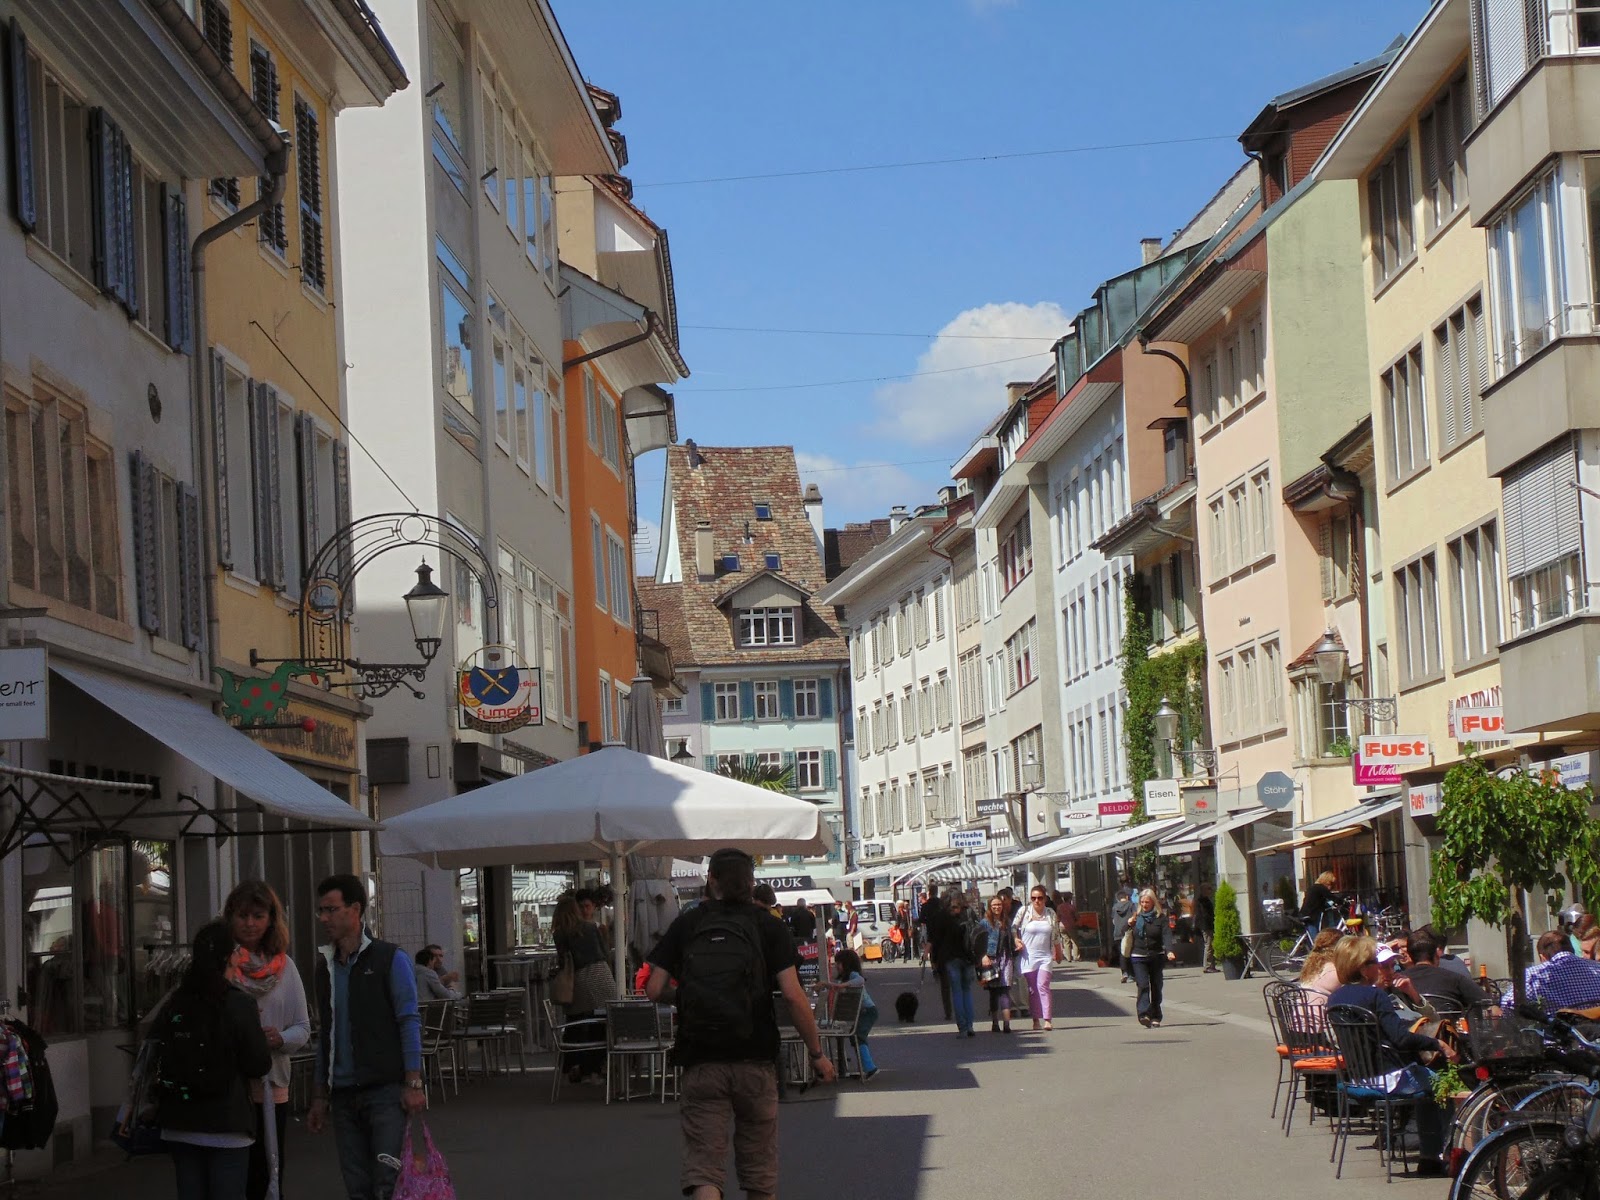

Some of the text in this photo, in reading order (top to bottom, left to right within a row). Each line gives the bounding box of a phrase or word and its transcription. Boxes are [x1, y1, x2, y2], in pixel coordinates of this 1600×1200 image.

[1365, 740, 1425, 757] Fust
[1264, 786, 1287, 795] Stöhr
[1410, 791, 1424, 811] Fust
[952, 831, 983, 840] Fritsche
